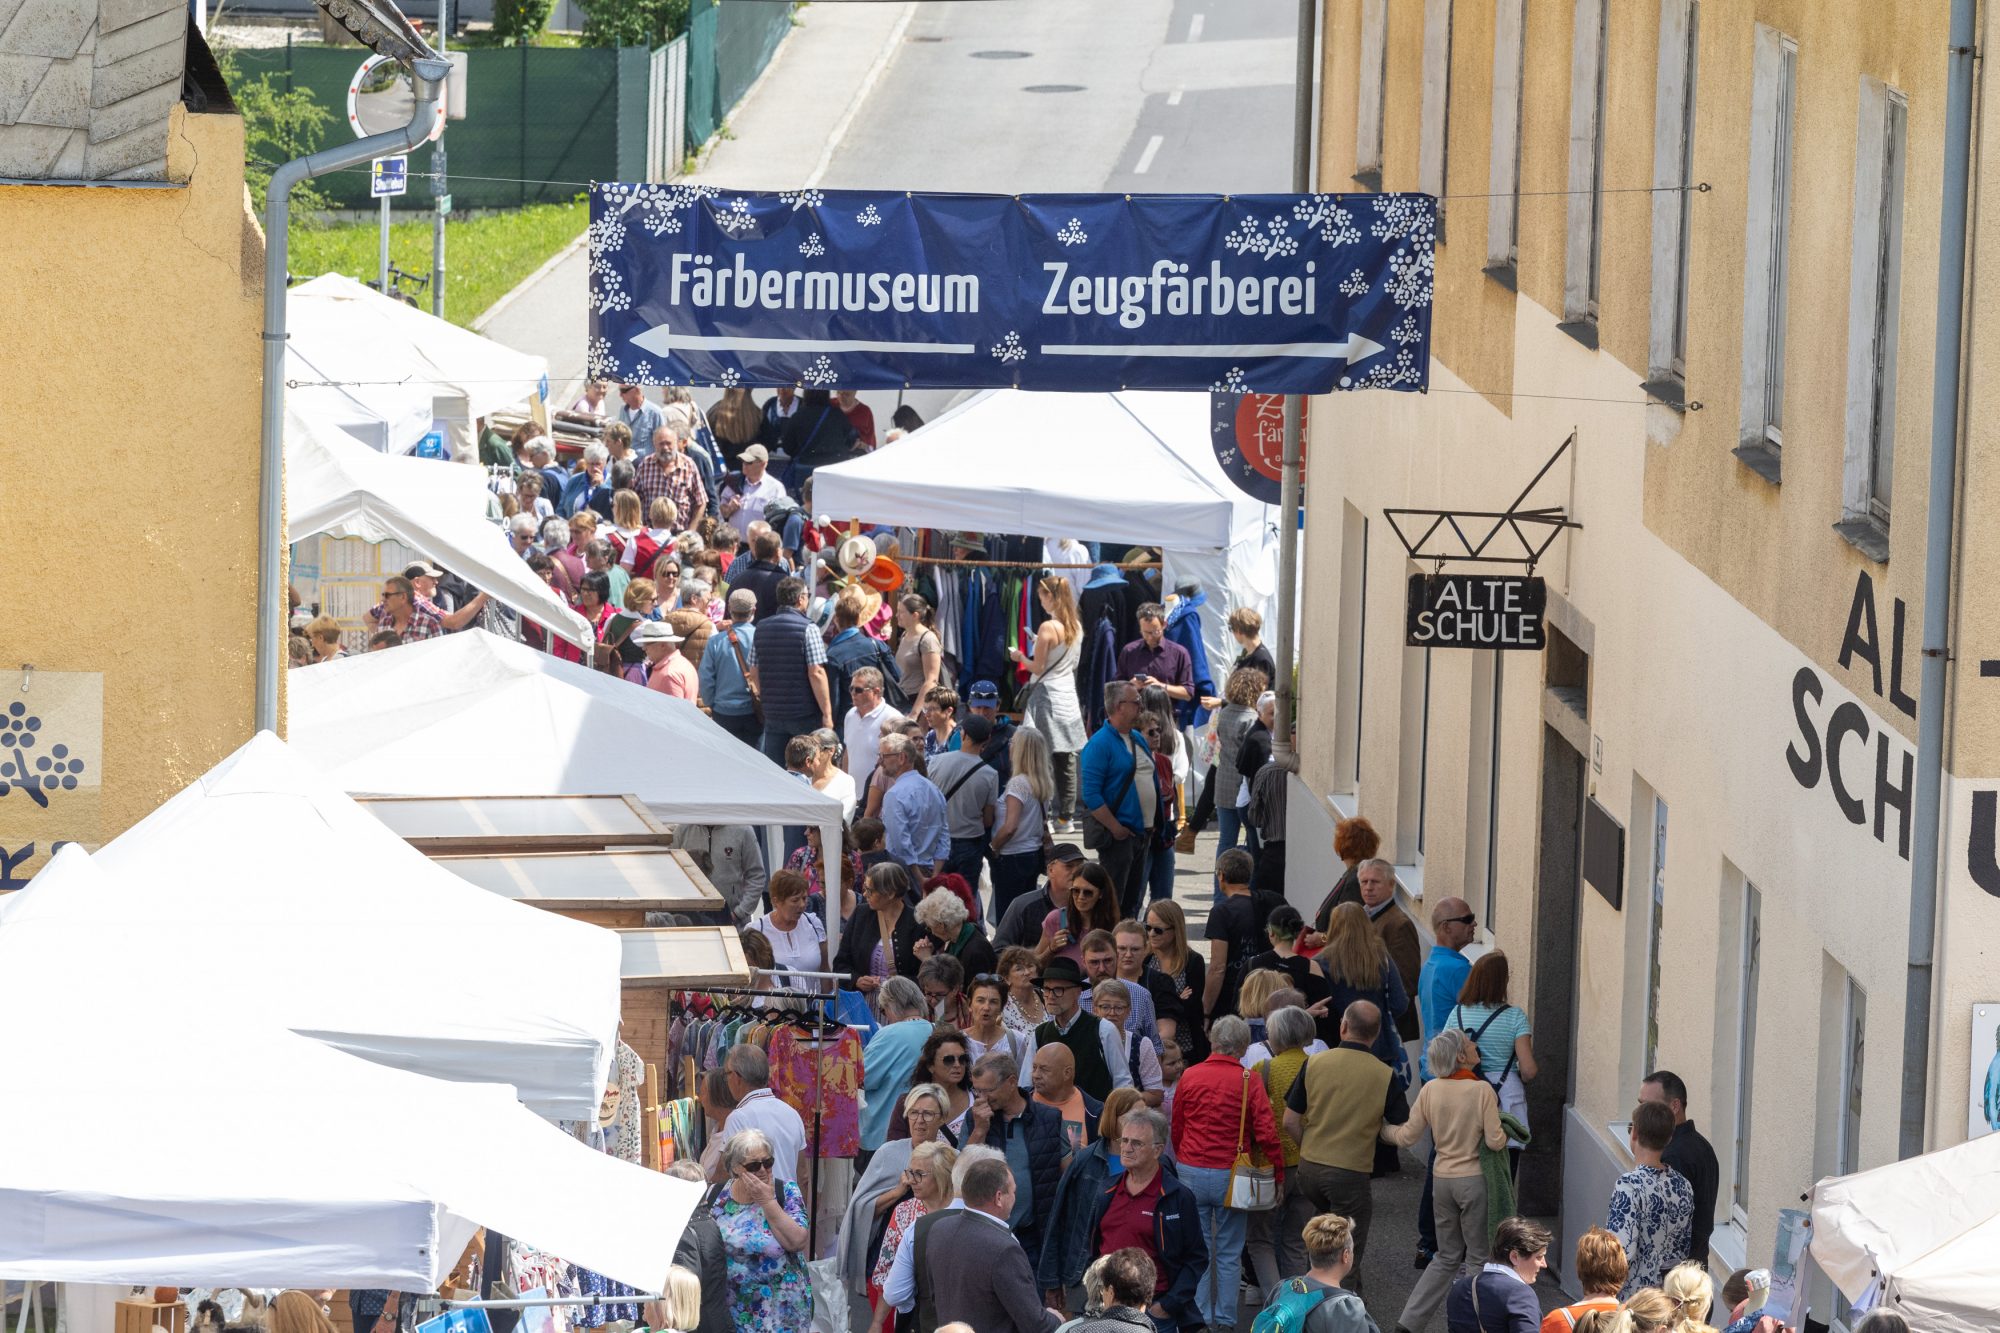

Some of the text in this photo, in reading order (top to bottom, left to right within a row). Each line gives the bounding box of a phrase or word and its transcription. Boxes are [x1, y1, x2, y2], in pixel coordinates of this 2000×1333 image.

[669, 252, 980, 313] Färbermuseum
[1041, 259, 1316, 329] Zeugfärberei
[1435, 580, 1523, 613] ALTE
[1412, 610, 1538, 645] SCHULE
